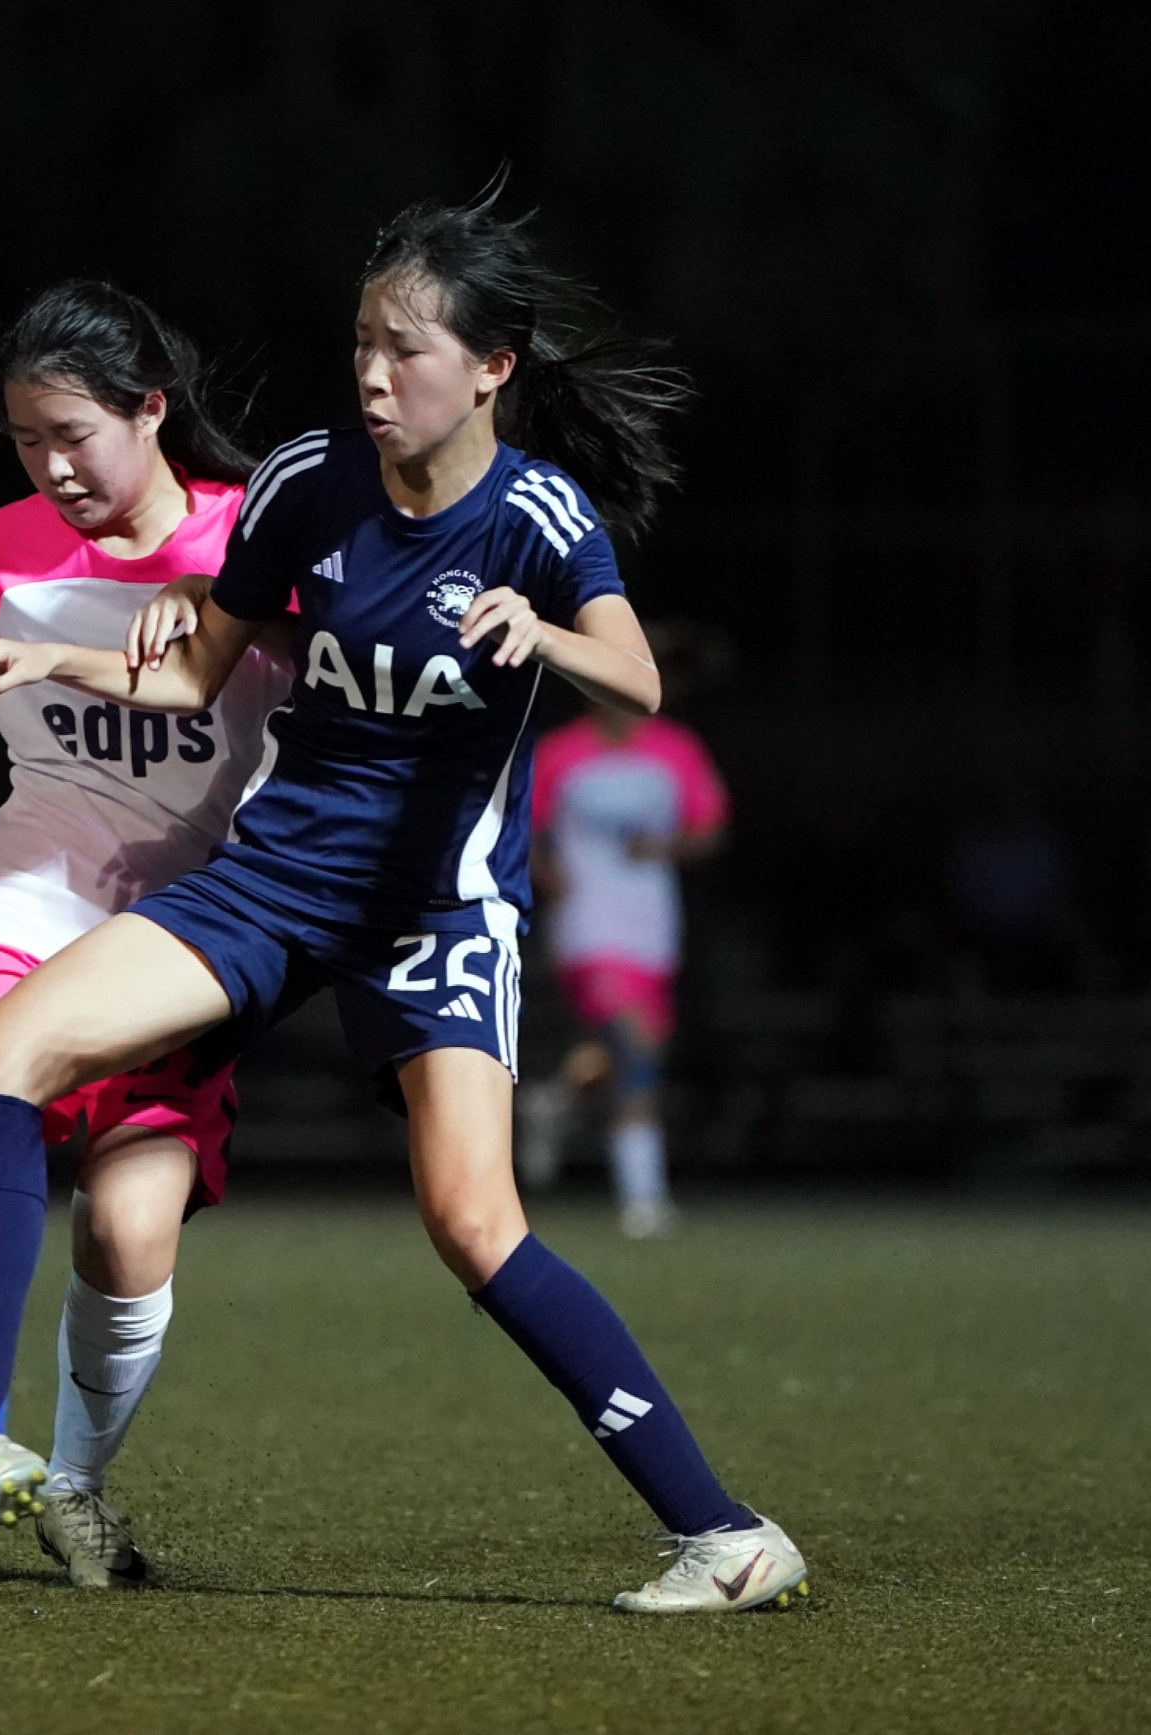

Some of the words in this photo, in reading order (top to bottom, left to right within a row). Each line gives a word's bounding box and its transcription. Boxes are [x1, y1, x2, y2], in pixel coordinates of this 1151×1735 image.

[431, 569, 462, 586] HONG
[462, 569, 485, 593] KONG
[304, 629, 488, 717] AIA
[41, 700, 216, 778] edps
